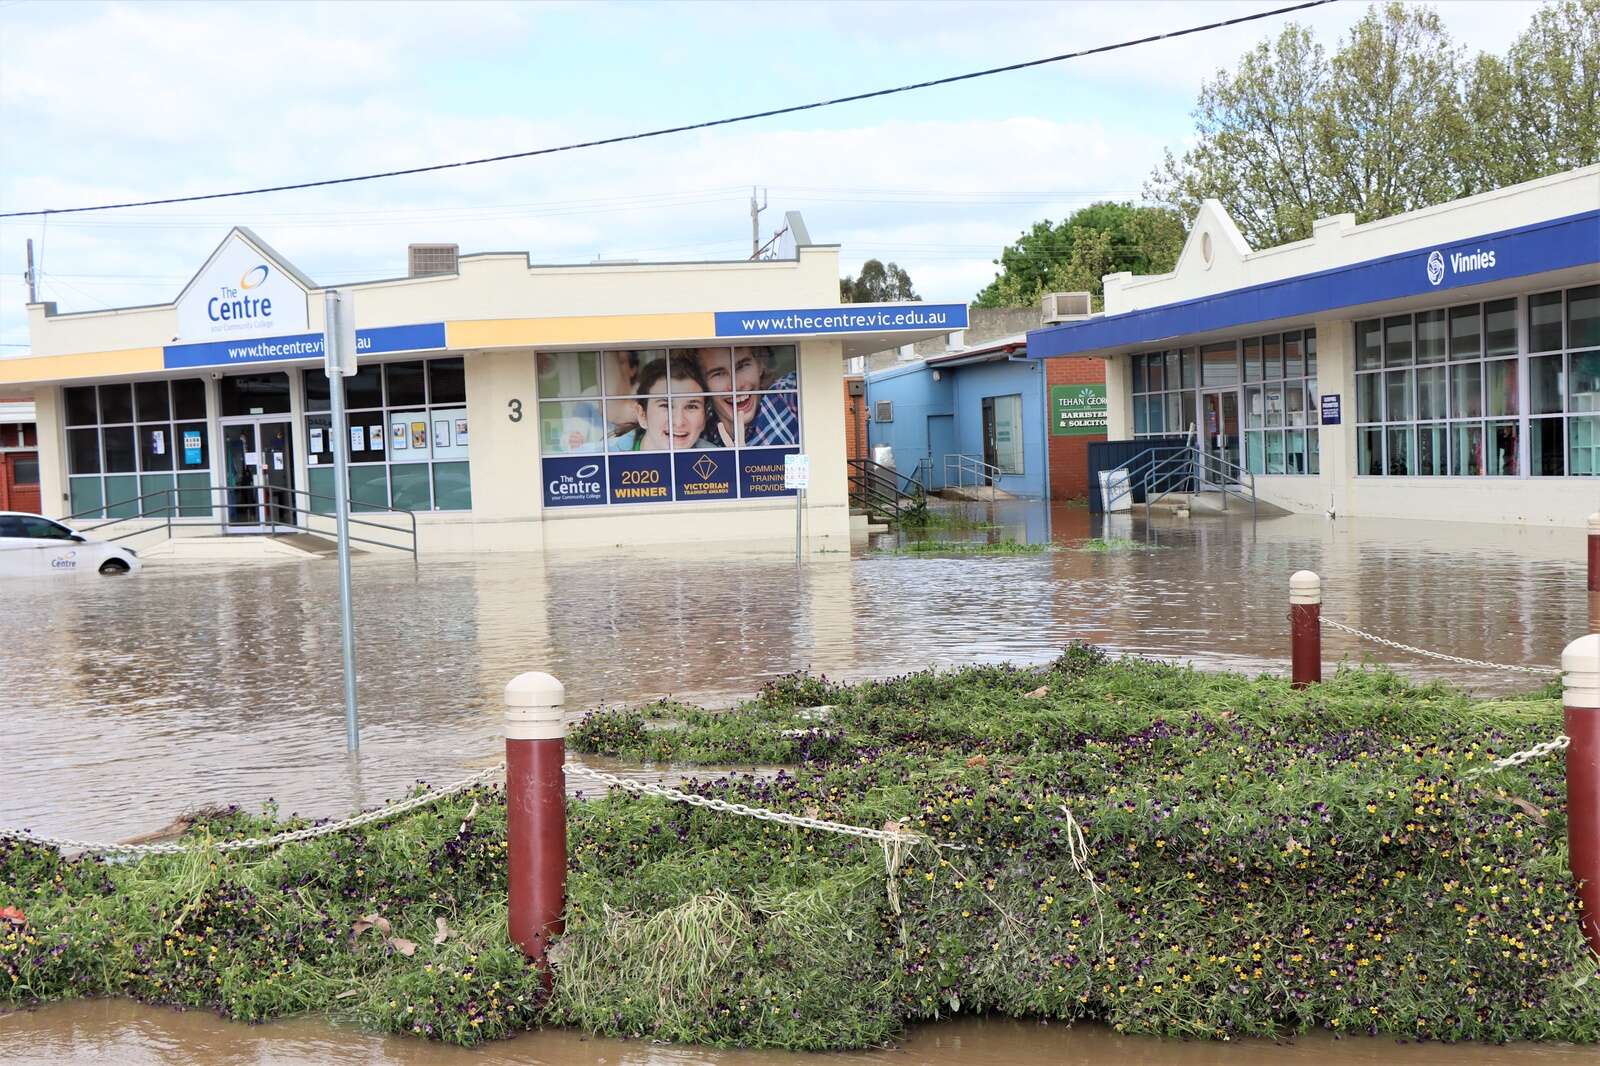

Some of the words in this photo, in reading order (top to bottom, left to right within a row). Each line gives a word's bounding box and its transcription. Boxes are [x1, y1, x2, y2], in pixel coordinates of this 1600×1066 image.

[1450, 248, 1496, 274] Vinnies
[221, 286, 238, 299] The
[207, 295, 272, 322] Centre
[741, 310, 947, 330] www.thecentre.vic.edu.au
[228, 337, 372, 359] www.thecentre.vi.au
[1058, 398, 1085, 406] TEHAN
[1086, 397, 1107, 405] GEOR
[508, 399, 522, 423] 3
[1061, 411, 1107, 419] BARRISTER
[1069, 419, 1107, 427] SOLICITO
[745, 465, 785, 473] COMMUNI
[560, 475, 574, 483] The
[621, 469, 660, 485] 2020
[752, 474, 785, 482] TRAININ
[550, 480, 601, 495] Centre
[683, 481, 729, 491] VICTORIAN
[750, 484, 785, 492] PROVIDE
[615, 486, 668, 499] WINNER
[51, 558, 77, 568] Centre
